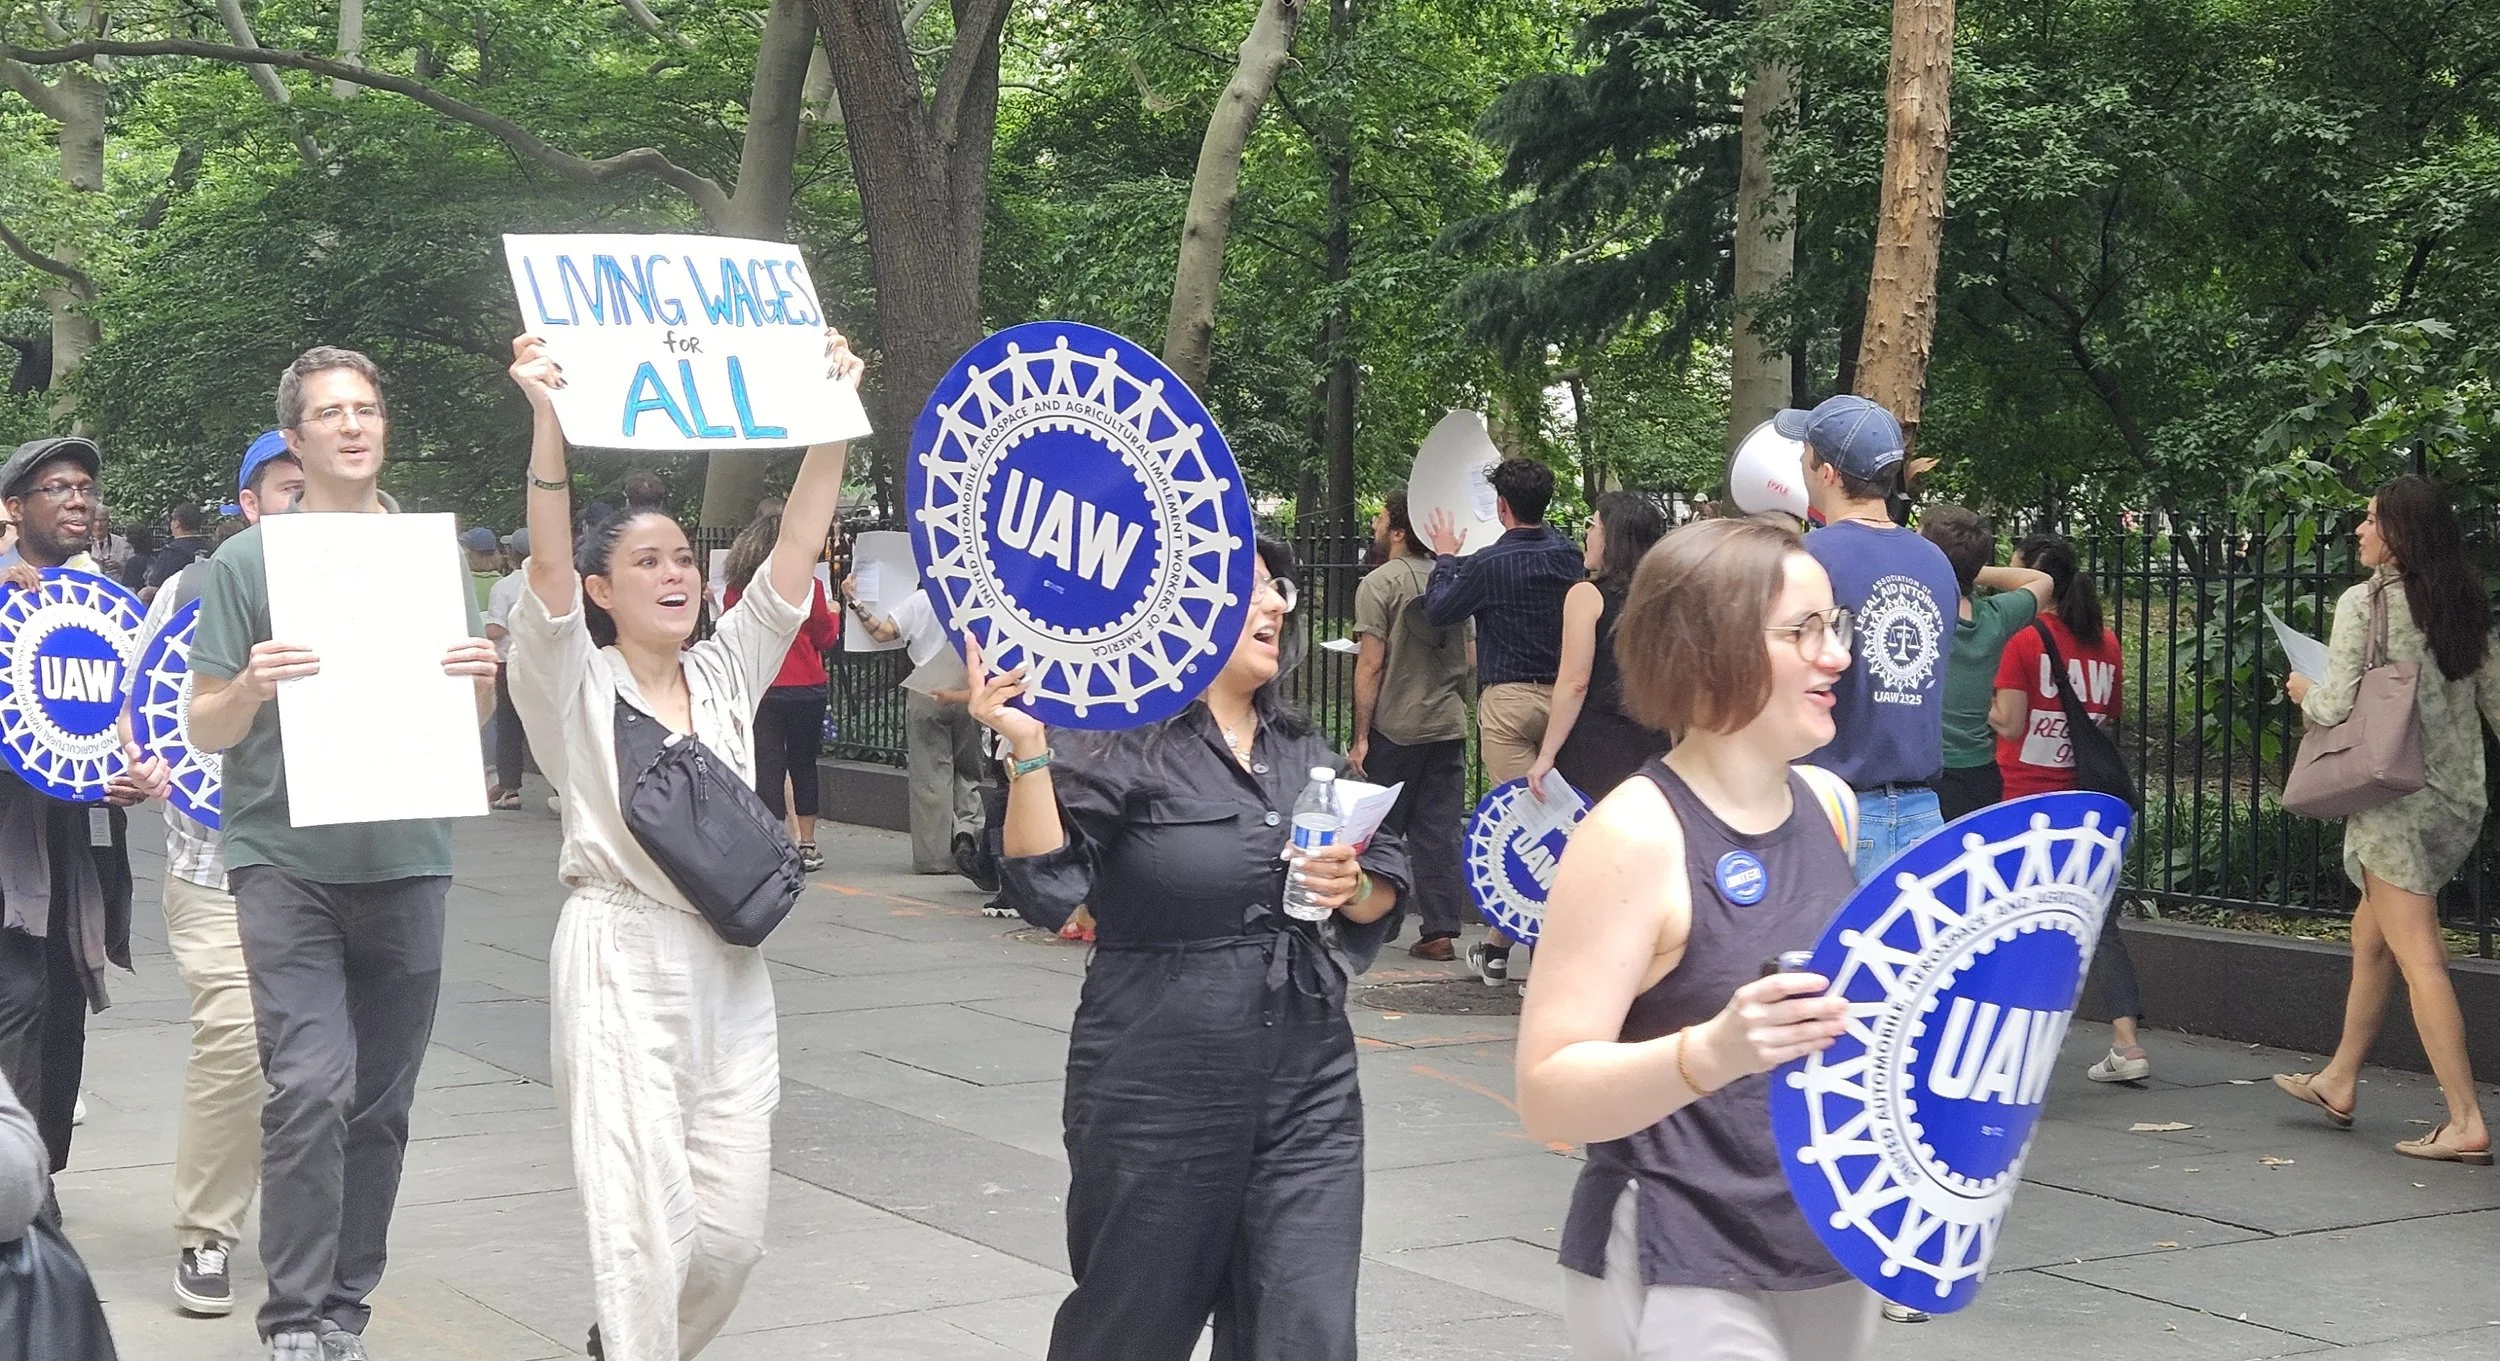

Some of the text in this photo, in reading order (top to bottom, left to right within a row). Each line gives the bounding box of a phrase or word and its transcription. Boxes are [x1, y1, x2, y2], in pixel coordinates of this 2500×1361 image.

[523, 254, 821, 327] LIVING WAGES
[622, 356, 788, 440] ALL
[962, 400, 1184, 657] UNITED AUTOMOBILE, AEROSPACE AND AGRICULTURAL IMPLEMENT WORKERS OF AMERICA
[996, 468, 1144, 592] UAW
[1854, 594, 1882, 631] LEGAL
[1880, 583, 1898, 598] AID
[1872, 574, 1920, 592] ASSOCIATION
[40, 655, 117, 704] UAW
[1874, 690, 1899, 703] UAW
[2039, 653, 2117, 706] UAW
[1927, 995, 2073, 1106] UAW
